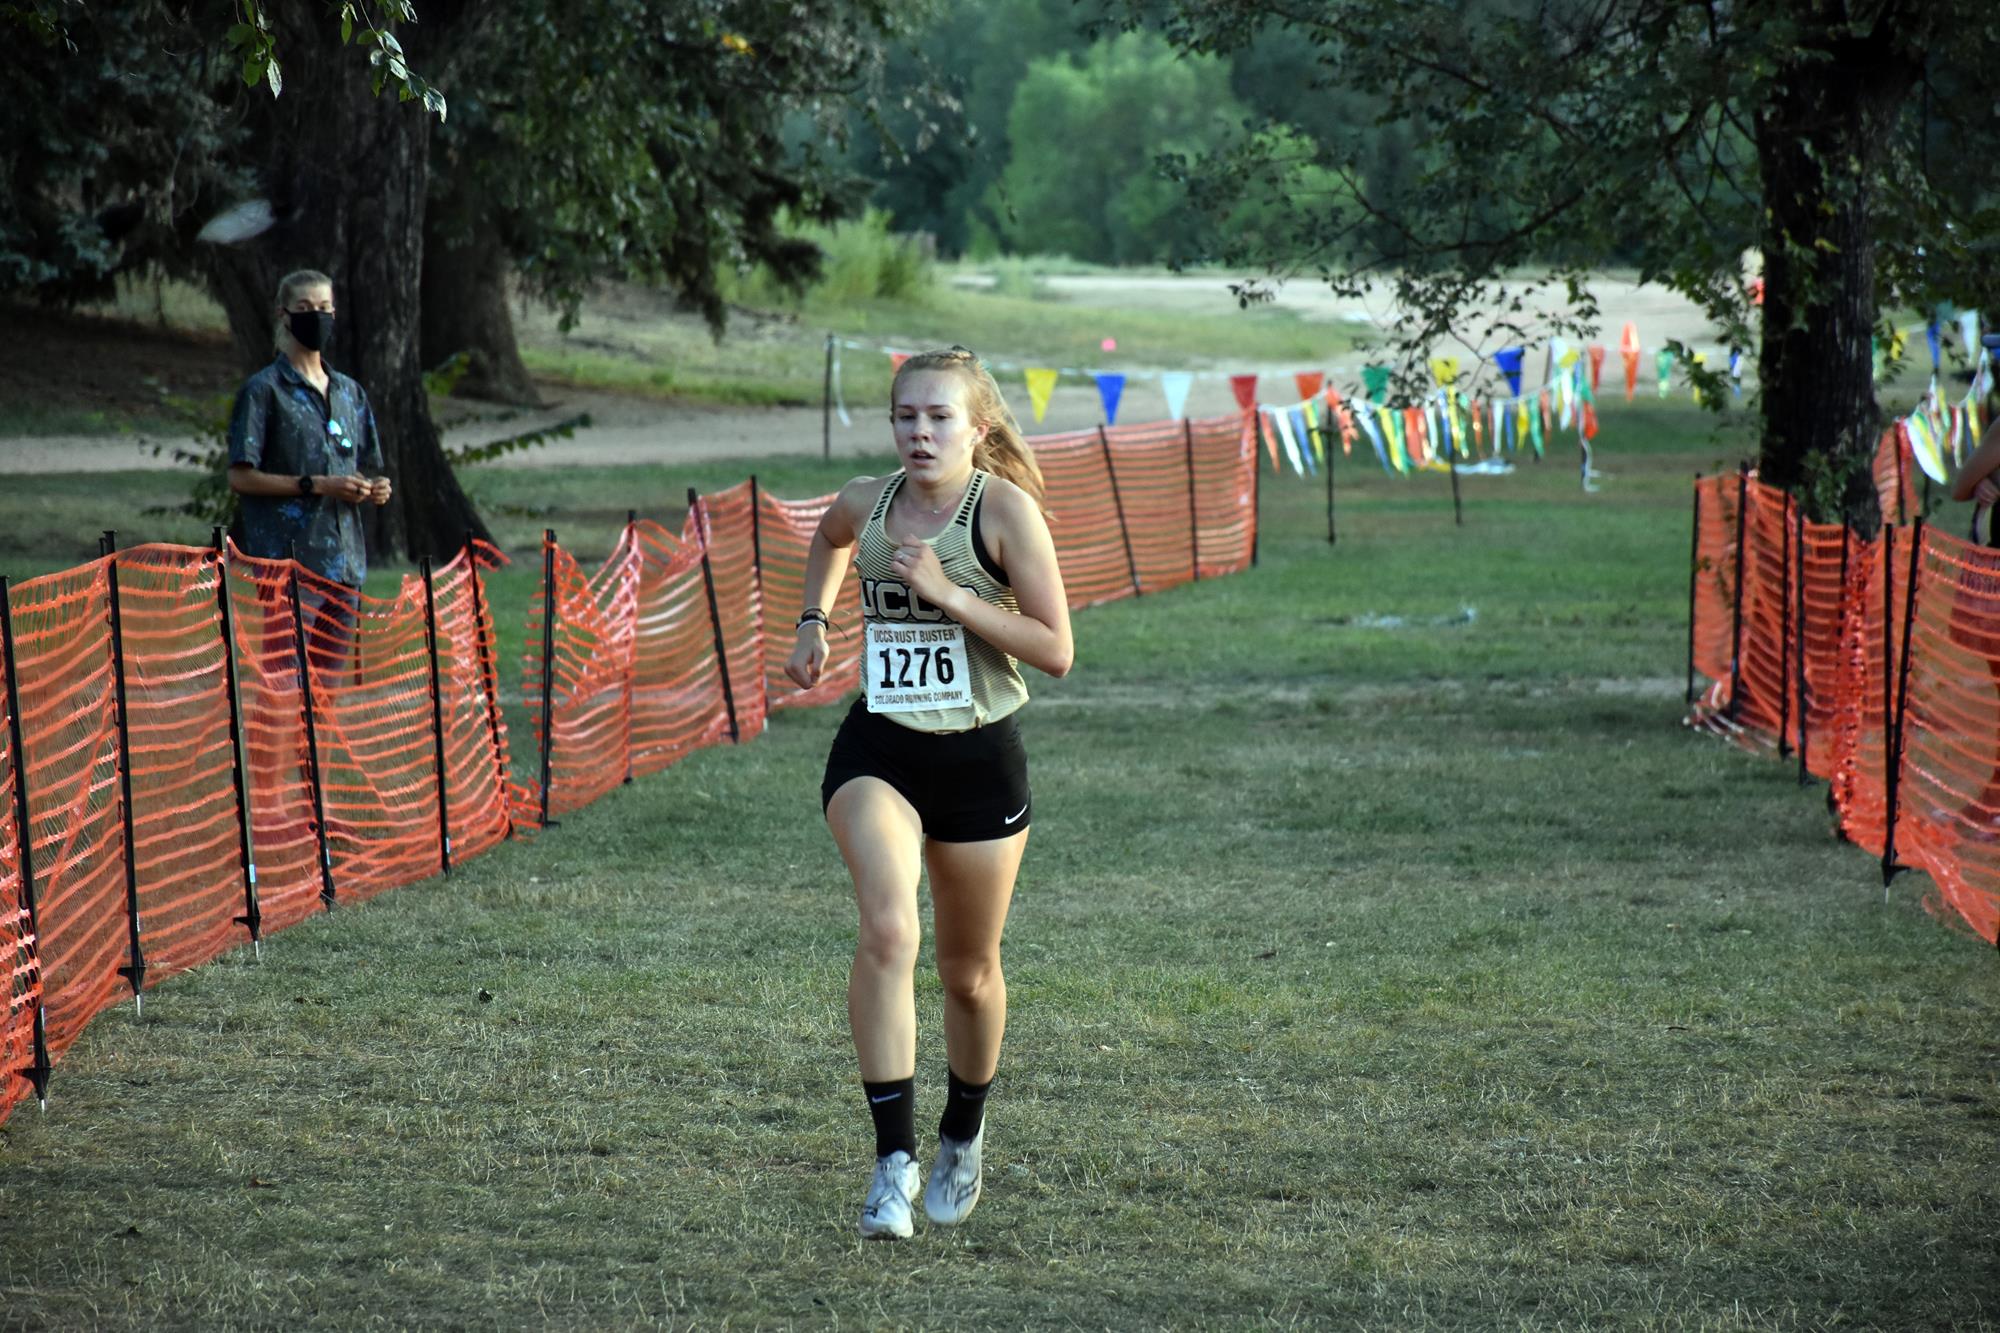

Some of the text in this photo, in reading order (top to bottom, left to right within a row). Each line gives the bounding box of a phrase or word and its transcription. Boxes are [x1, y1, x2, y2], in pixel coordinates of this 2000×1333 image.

[861, 579, 979, 621] UCC
[874, 629, 956, 643] UCCS RUST BUSTER
[879, 646, 955, 689] 1276
[875, 691, 963, 705] COLORADO RUNNING COMPANY
